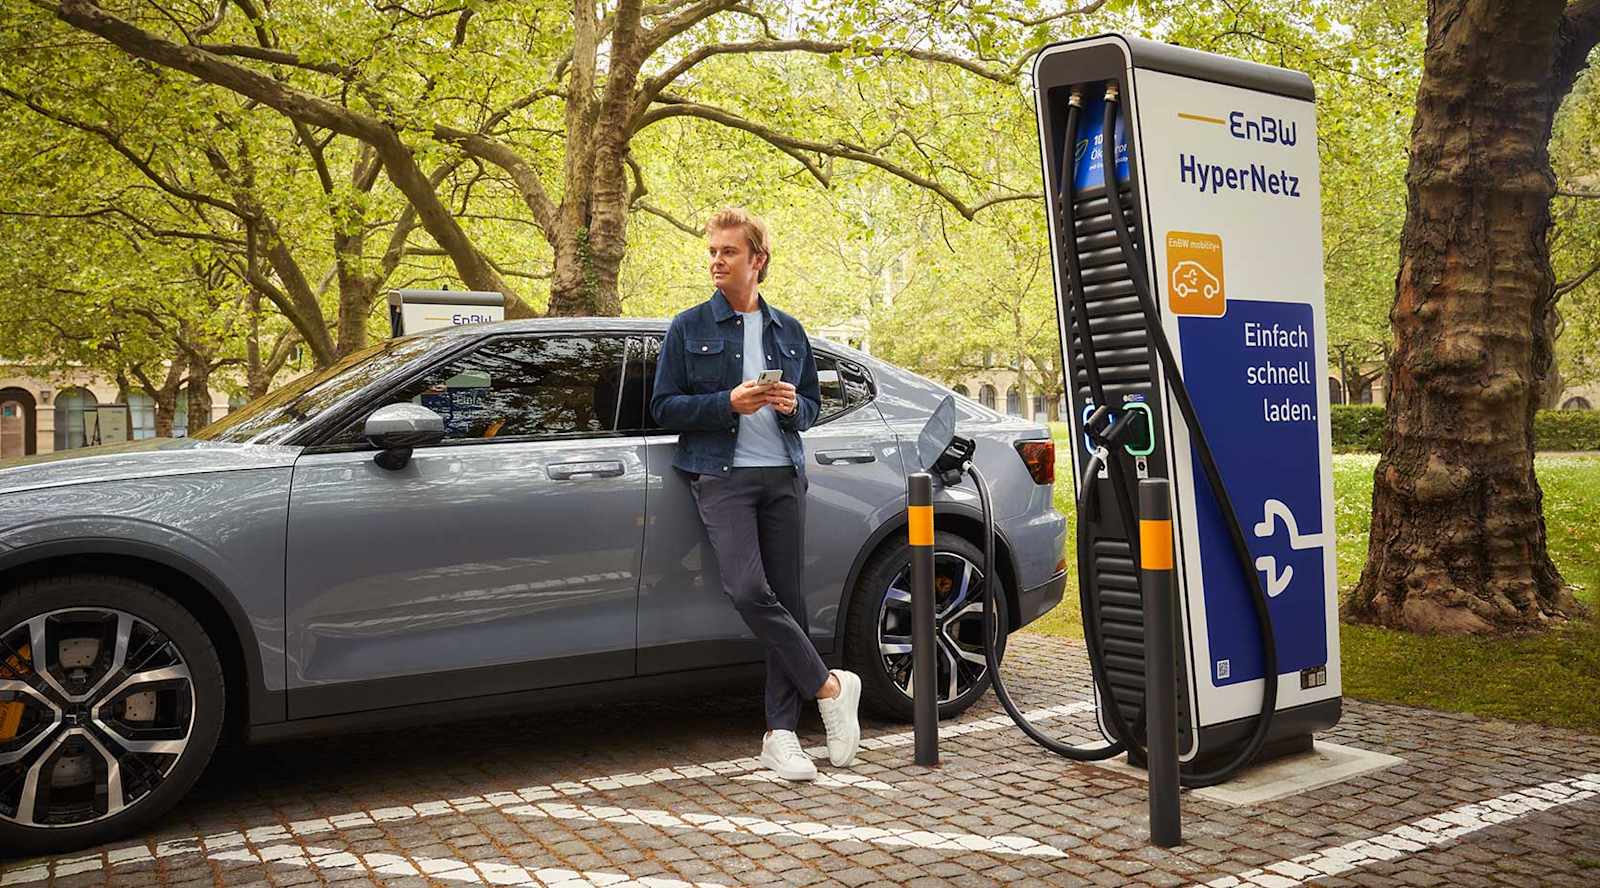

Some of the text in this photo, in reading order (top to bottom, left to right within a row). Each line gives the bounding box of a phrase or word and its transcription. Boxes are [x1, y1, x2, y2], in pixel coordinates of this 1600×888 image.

[1229, 111, 1297, 147] EnBW
[1180, 153, 1300, 197] HyperNetz
[1168, 237, 1190, 249] EnBW
[1245, 322, 1308, 348] Einfach
[1247, 360, 1311, 384] schnell
[1264, 397, 1316, 422] laden.
